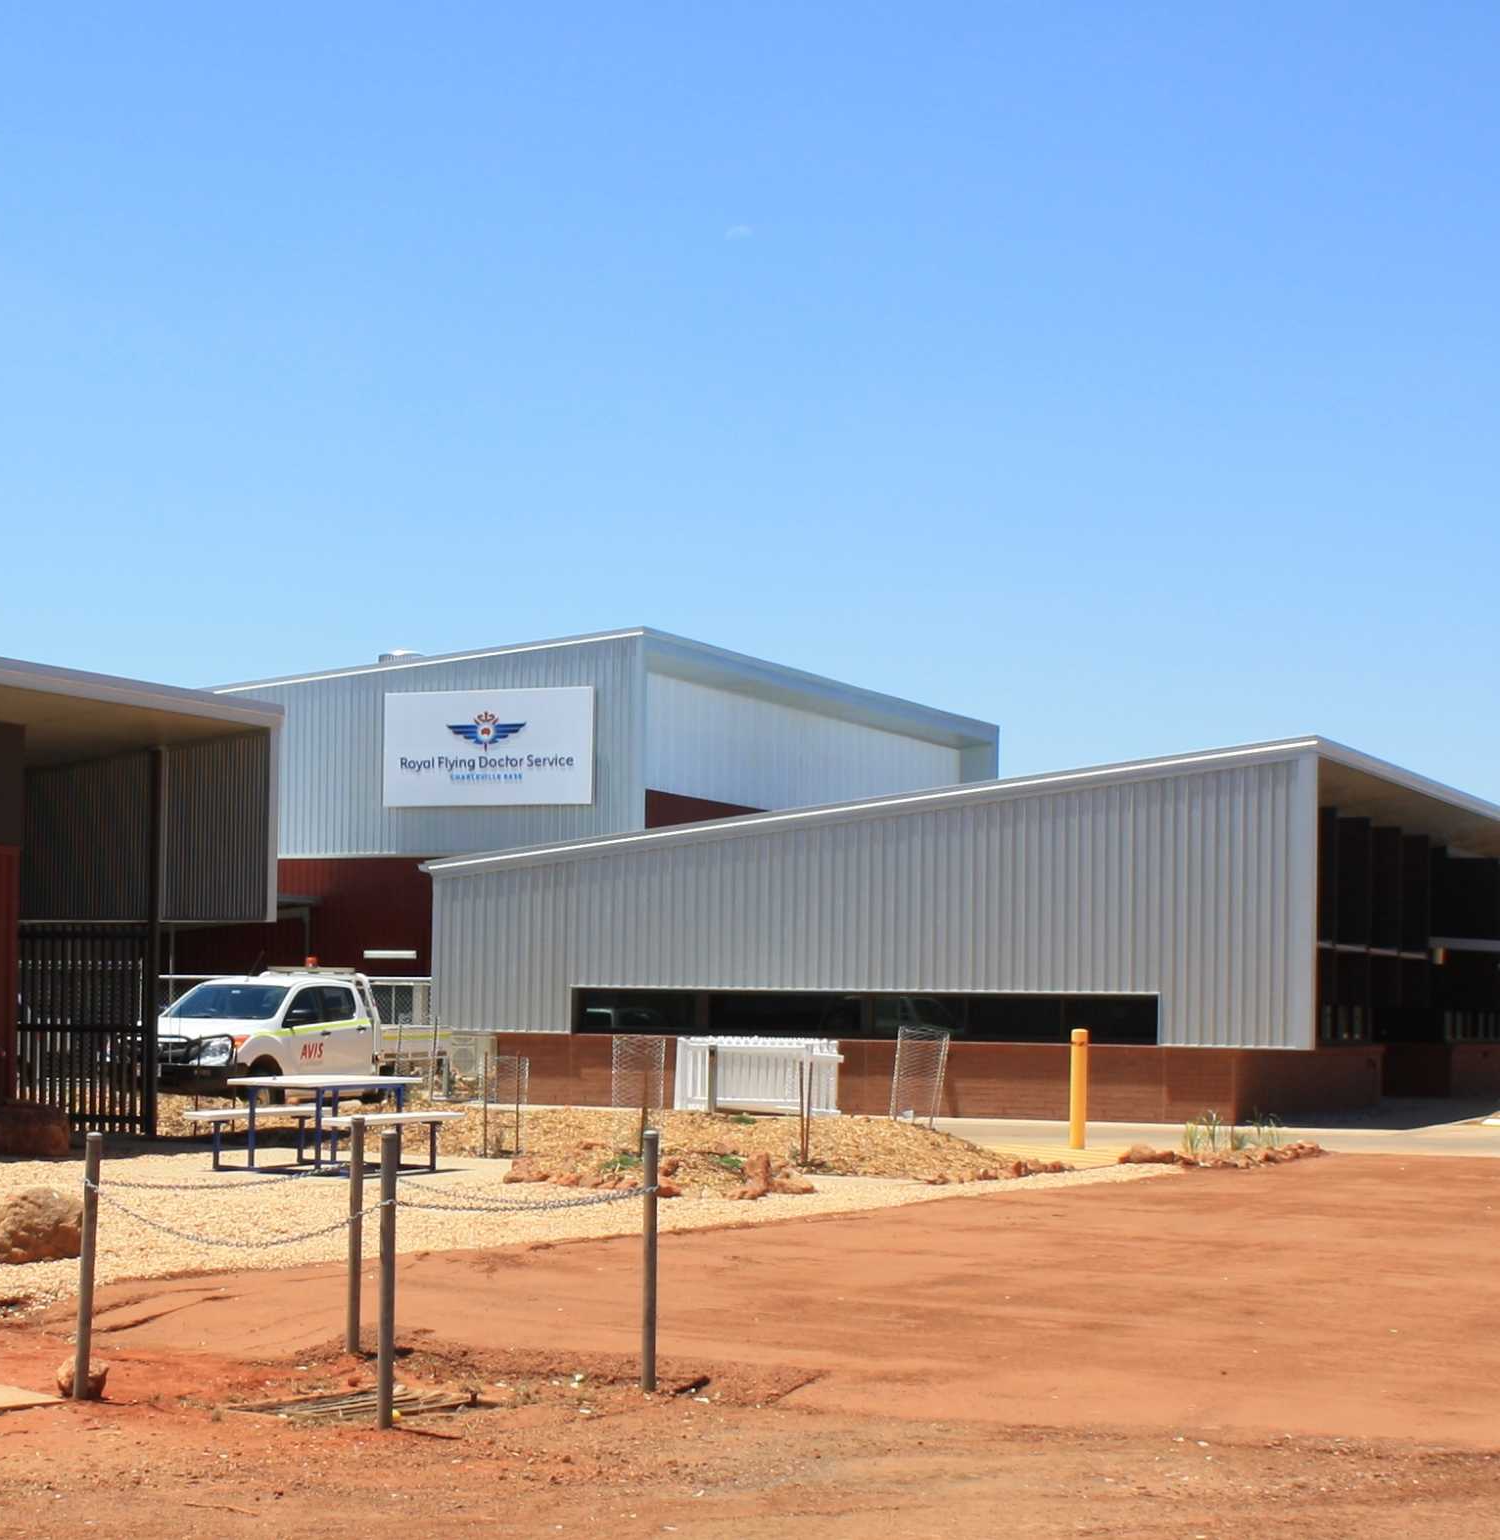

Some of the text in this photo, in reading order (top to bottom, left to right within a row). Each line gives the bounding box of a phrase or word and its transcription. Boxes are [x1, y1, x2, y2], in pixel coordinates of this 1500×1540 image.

[400, 754, 574, 772] Royal Flying Doctor Service
[300, 1042, 325, 1060] AVIS
